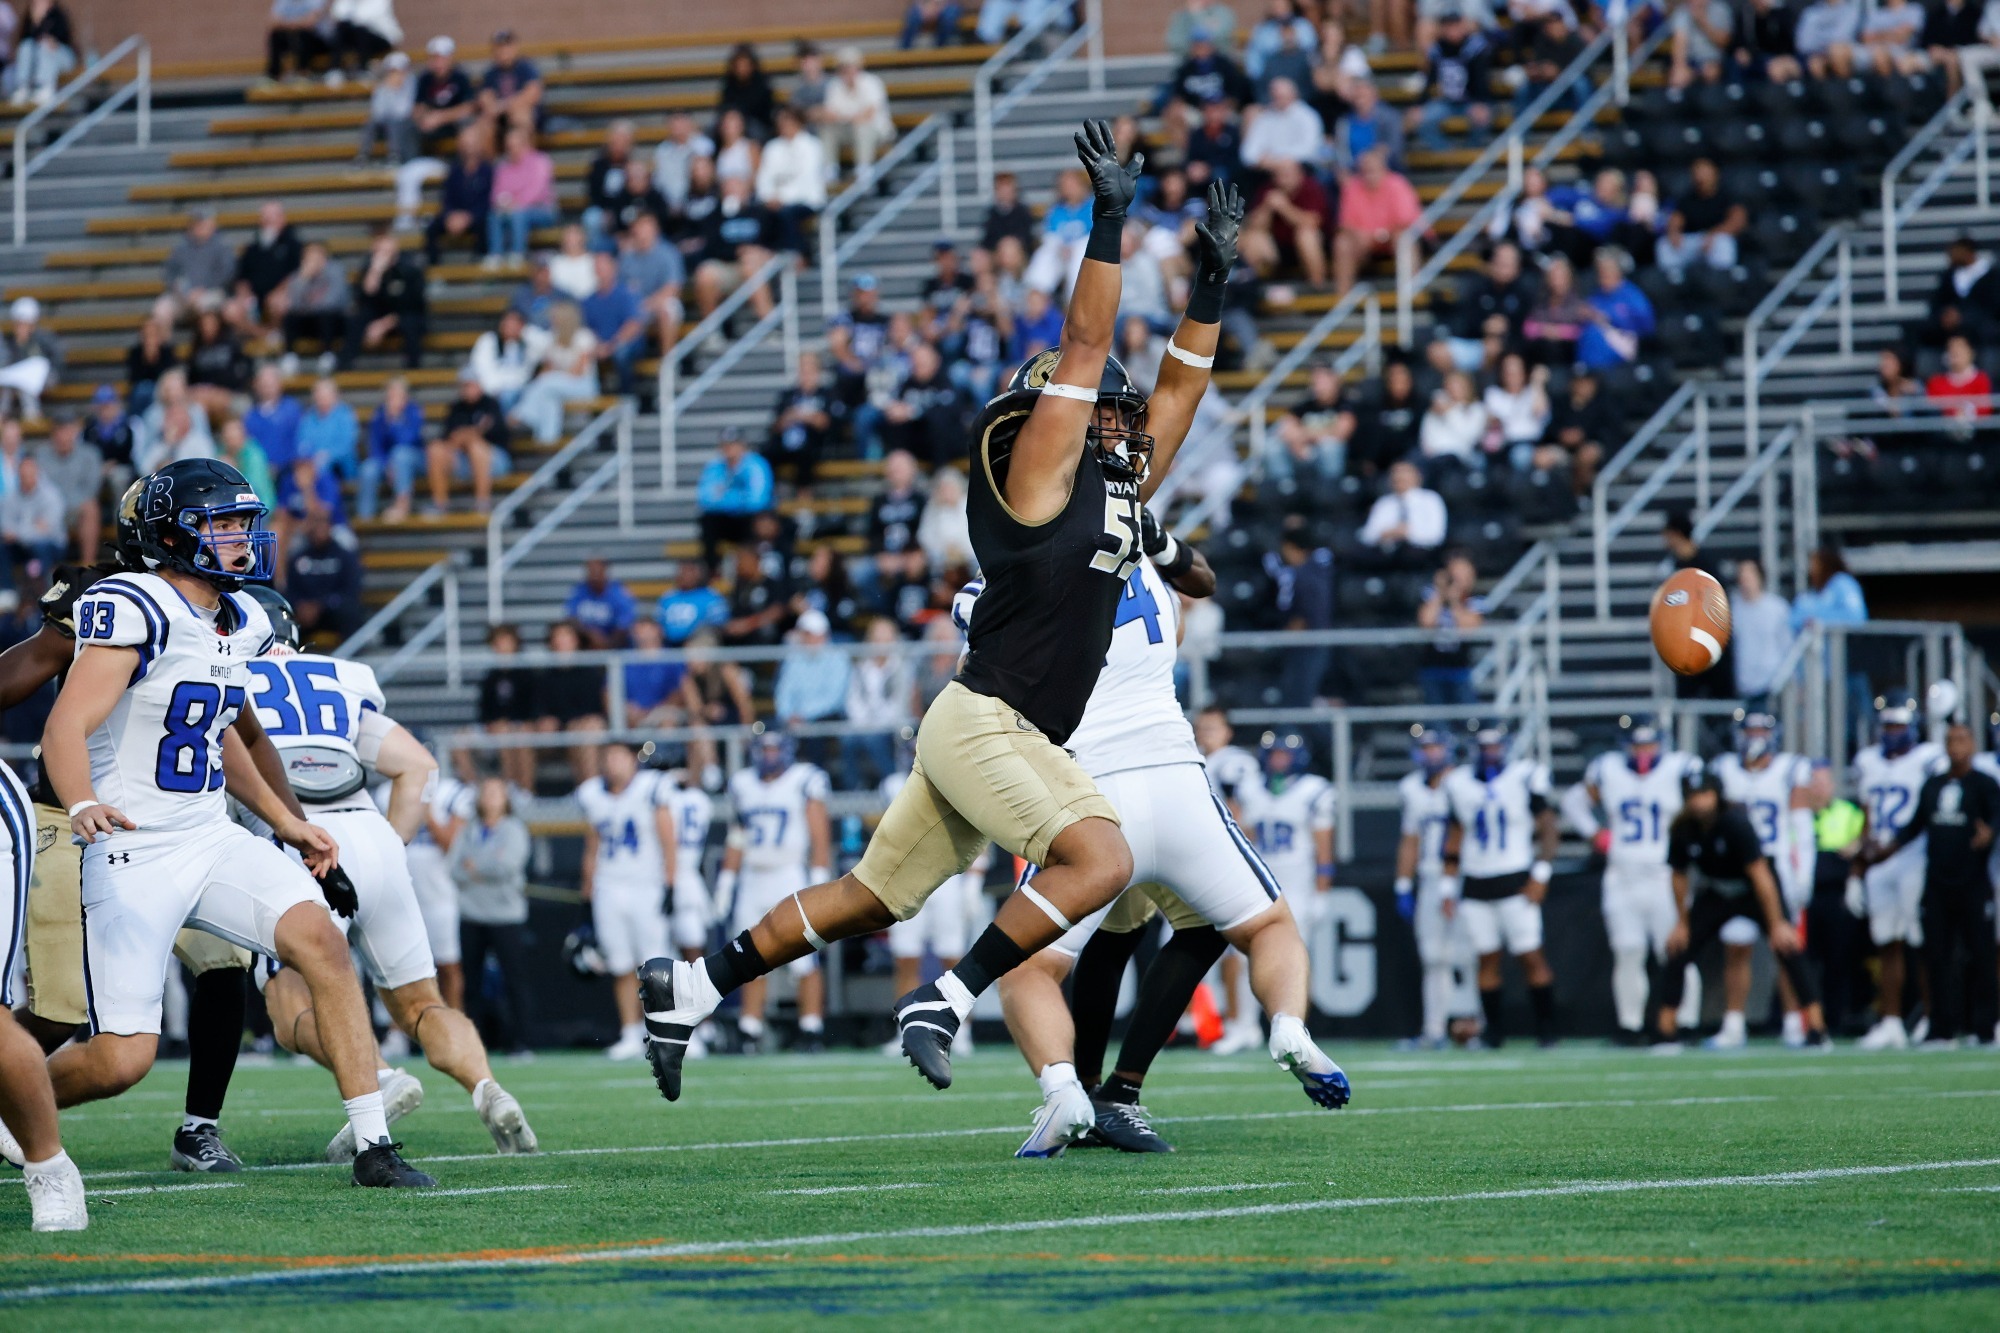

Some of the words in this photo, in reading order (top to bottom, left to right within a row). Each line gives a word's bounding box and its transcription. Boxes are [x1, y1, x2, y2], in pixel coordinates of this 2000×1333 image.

[145, 475, 174, 522] B
[79, 601, 115, 639] 83
[210, 665, 232, 679] BENTLEY
[246, 660, 350, 741] 36
[743, 807, 787, 848] 57
[1475, 808, 1507, 851] 41
[1620, 799, 1661, 842] 51
